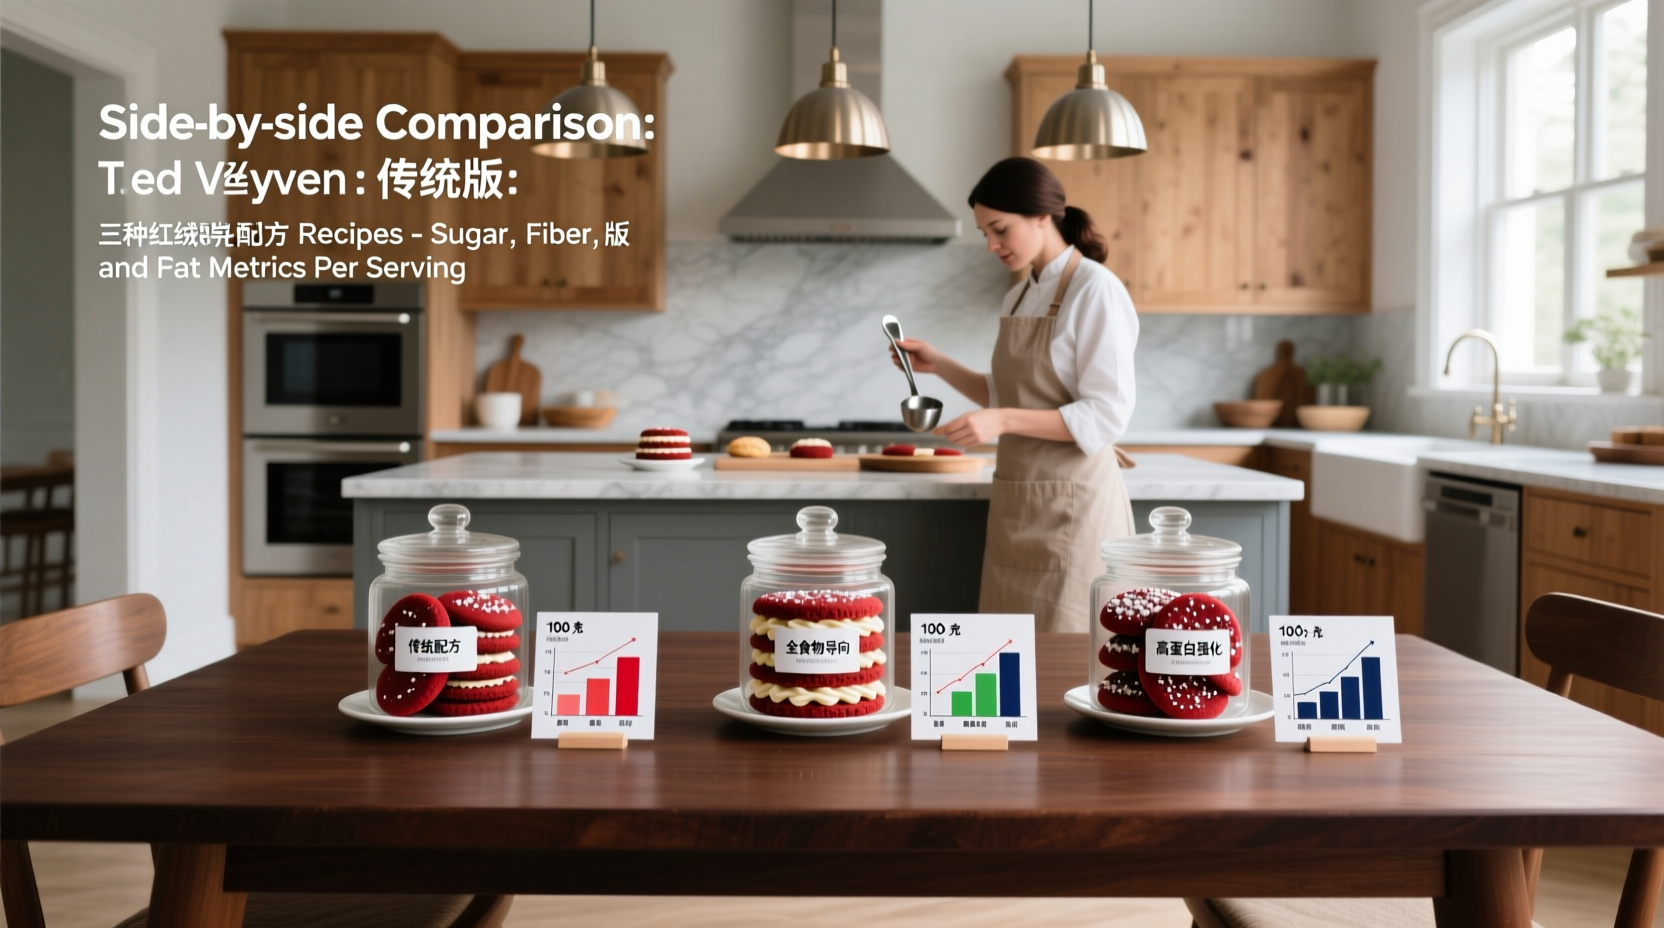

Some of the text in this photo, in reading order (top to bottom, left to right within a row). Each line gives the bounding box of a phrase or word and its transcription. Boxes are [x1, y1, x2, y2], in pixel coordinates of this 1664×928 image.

[546, 621, 570, 633] 100
[921, 622, 946, 635] 100
[786, 639, 850, 655] 全食物导向
